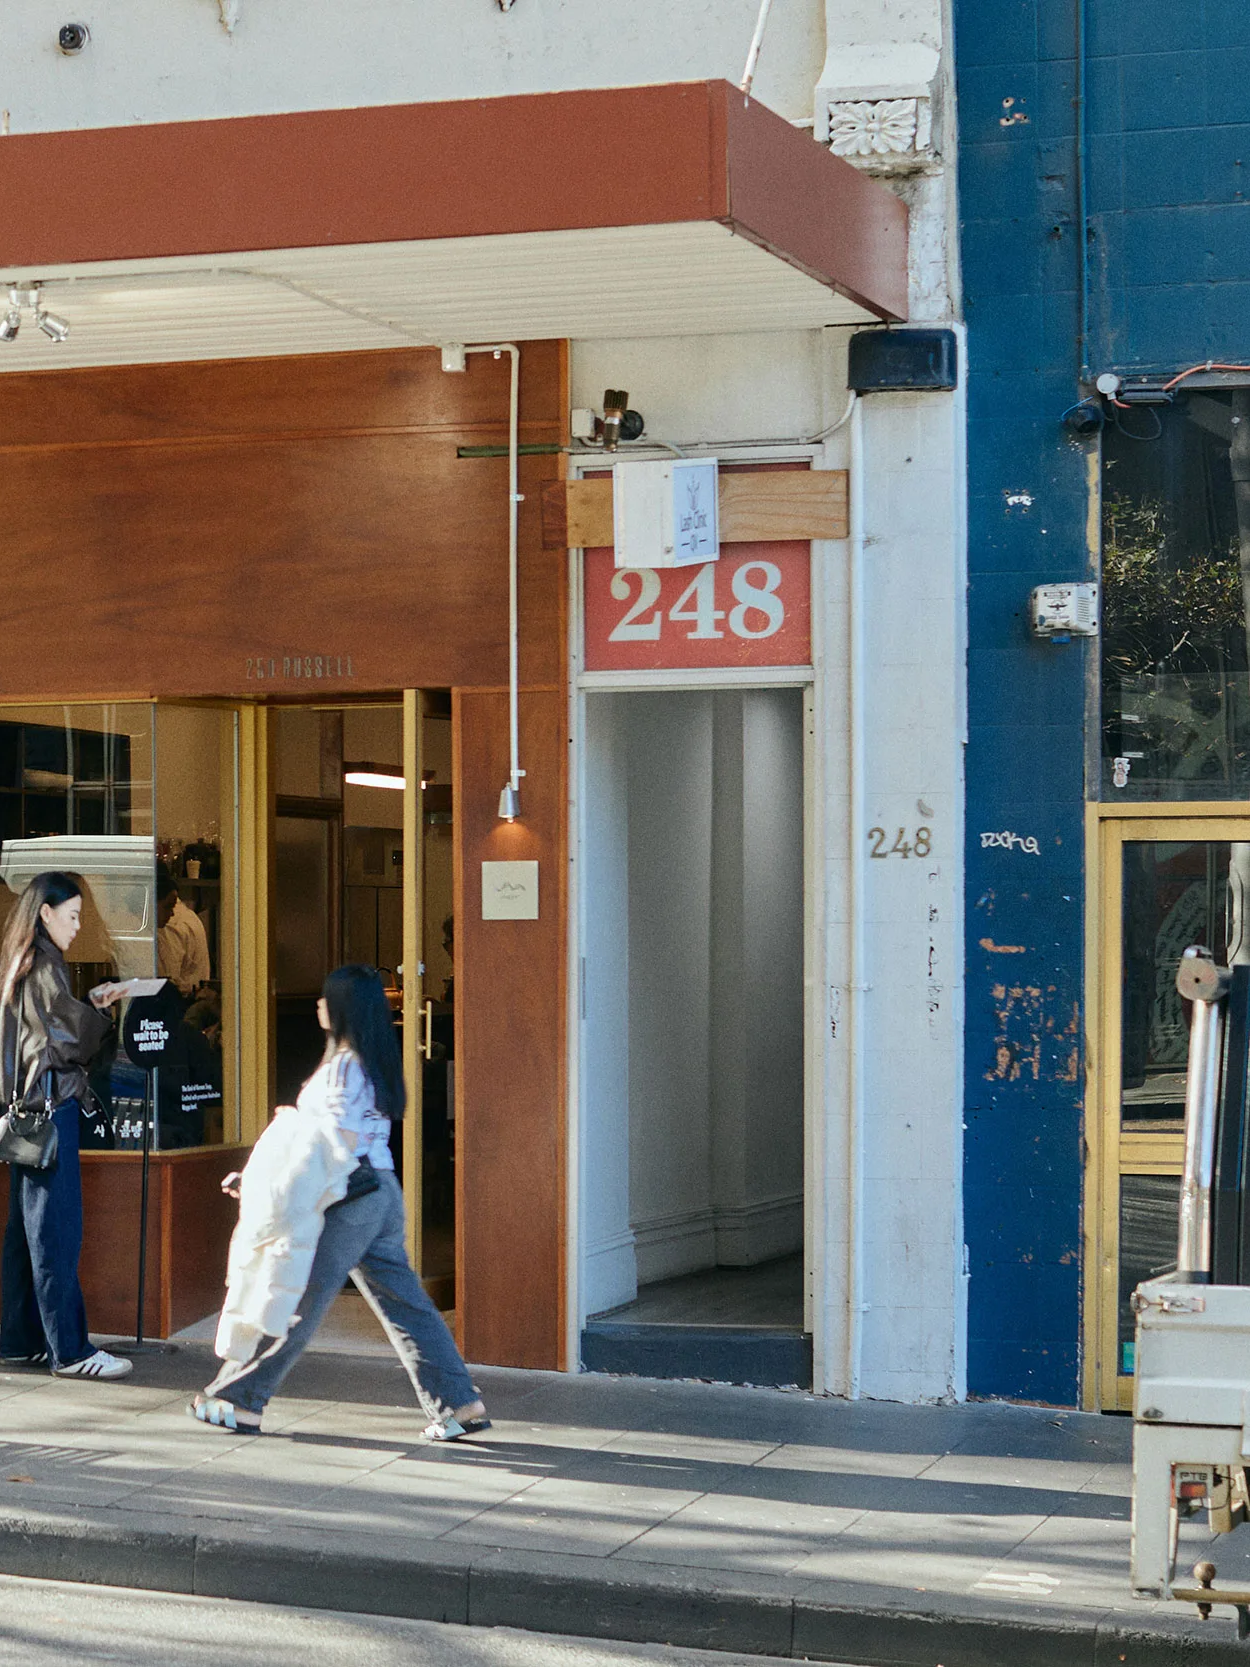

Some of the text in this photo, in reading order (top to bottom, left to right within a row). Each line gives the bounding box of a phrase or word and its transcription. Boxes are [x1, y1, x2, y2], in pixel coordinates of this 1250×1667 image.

[608, 560, 785, 641] 248
[282, 655, 354, 679] RUSSELL
[867, 826, 933, 858] 248
[140, 1019, 164, 1031] Please
[133, 1030, 169, 1041] wait to be
[138, 1040, 164, 1051] seated
